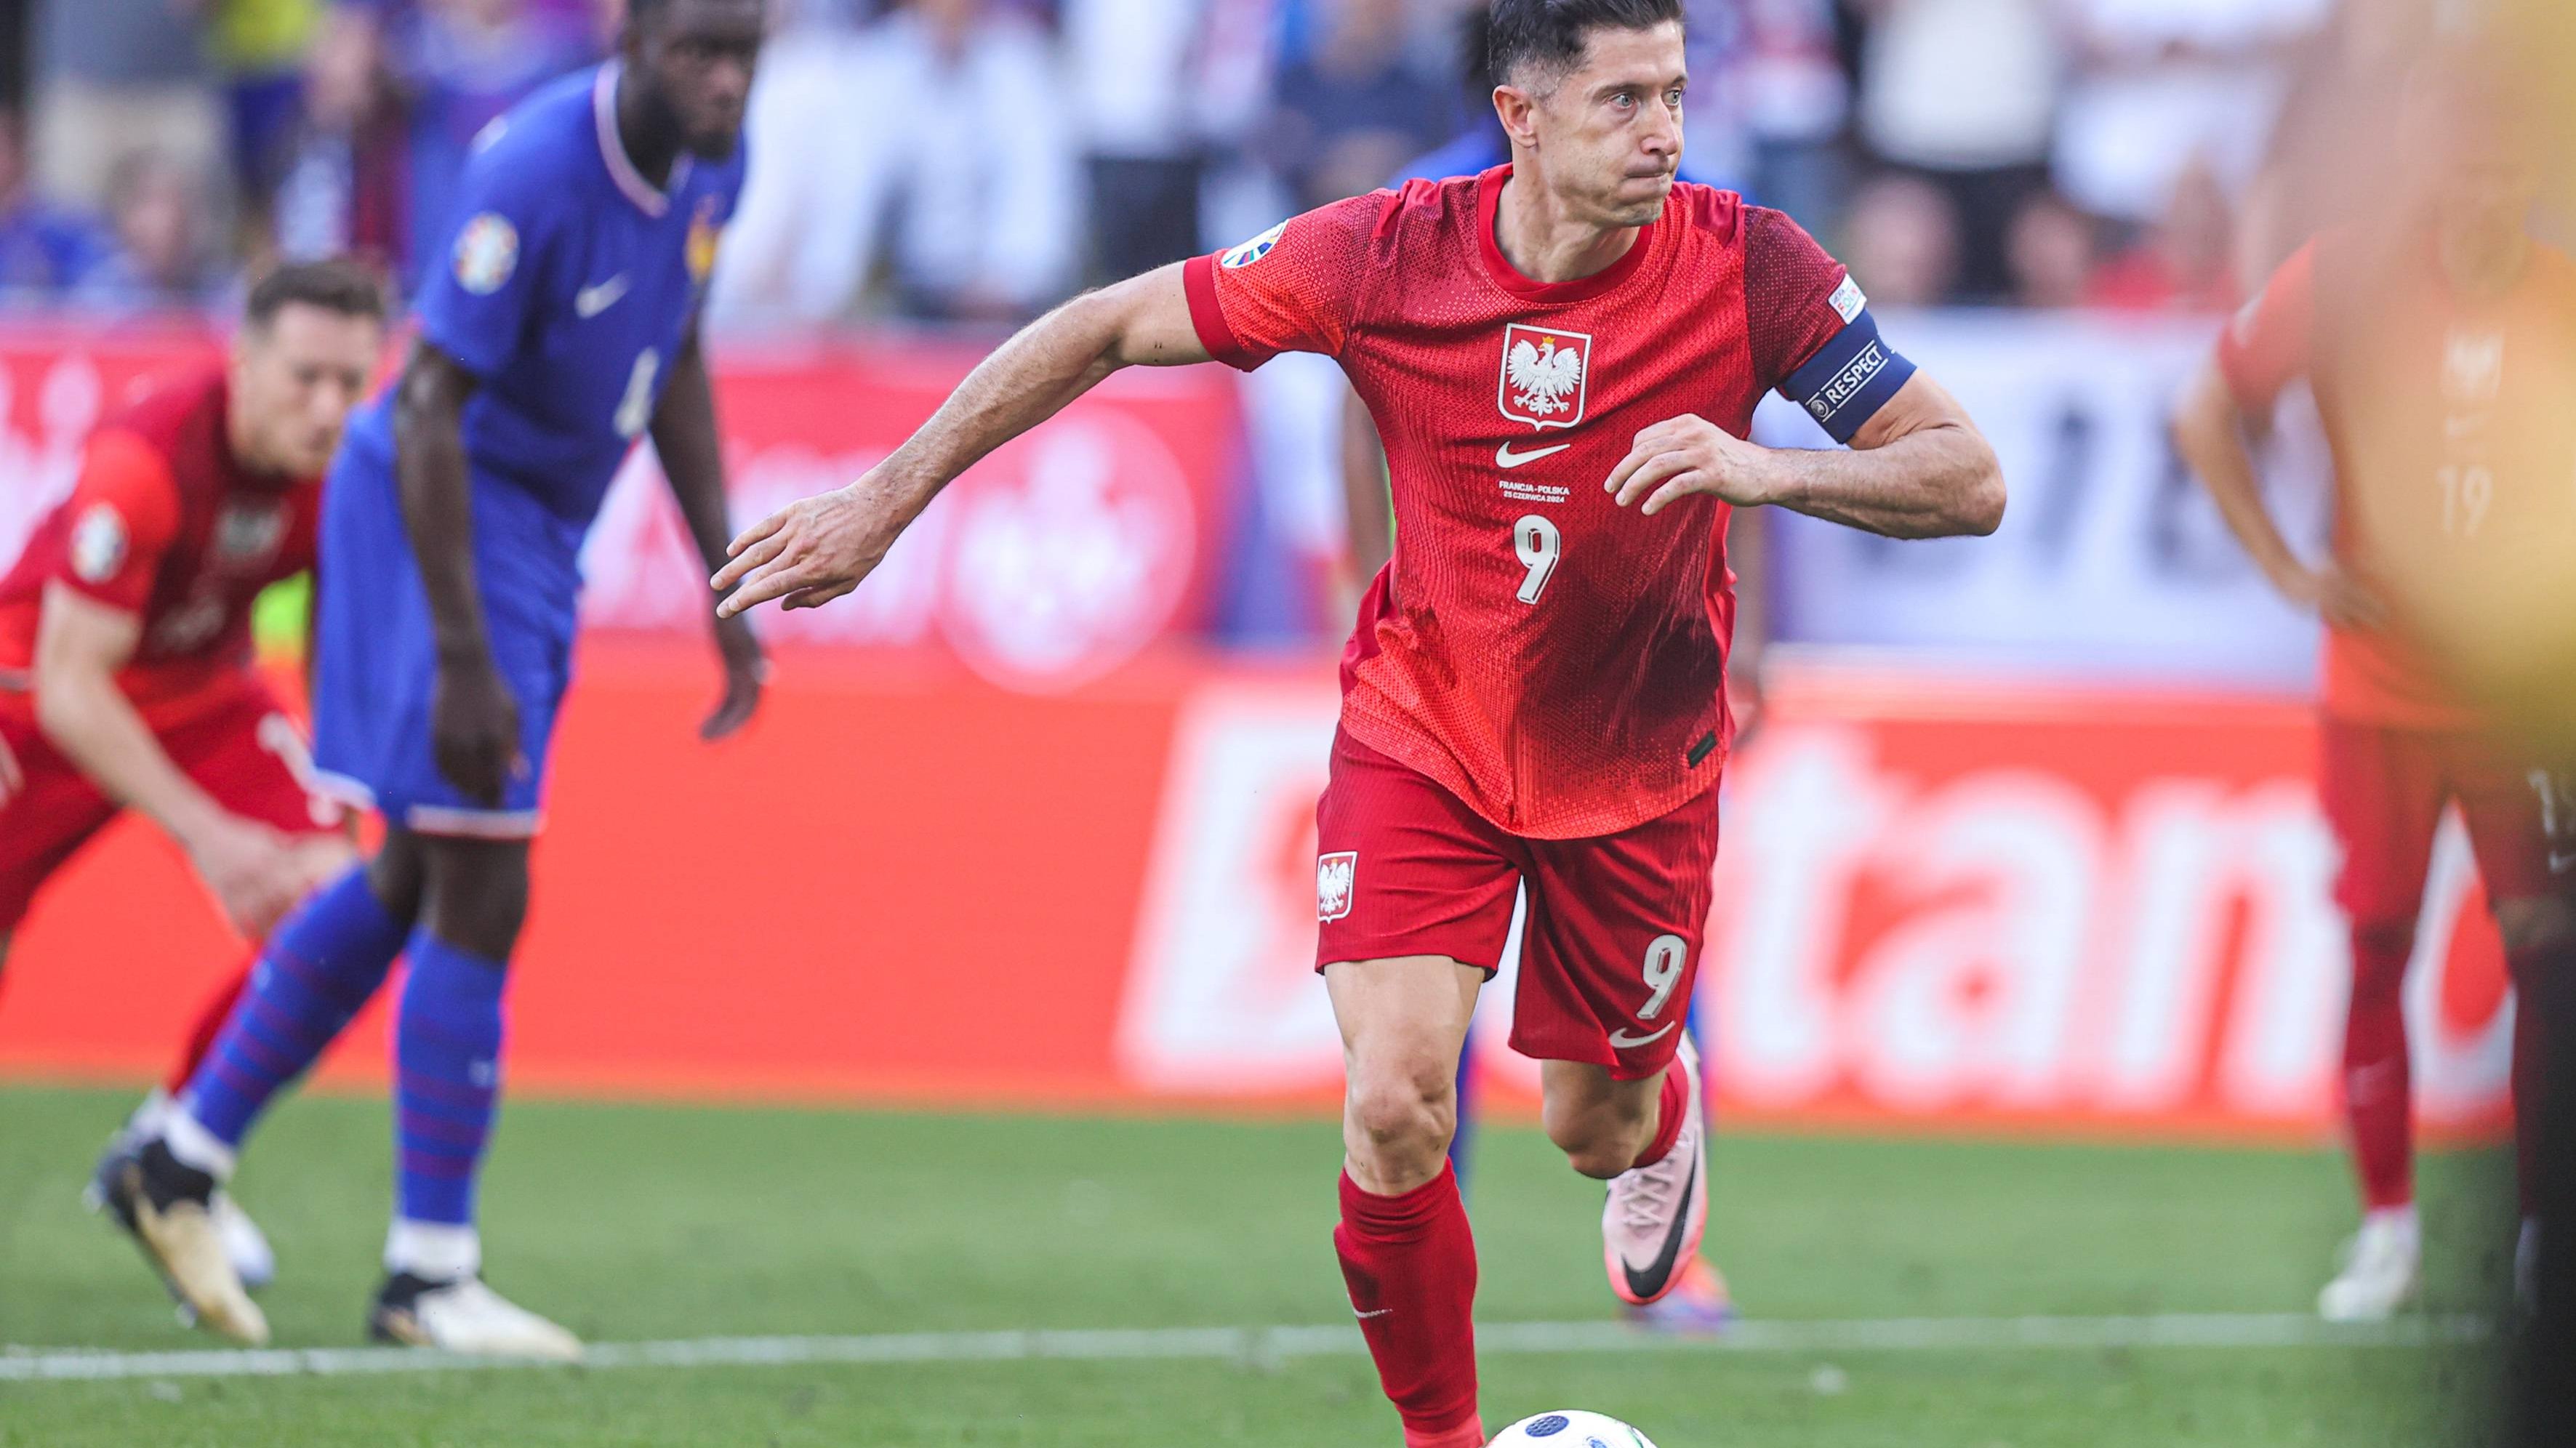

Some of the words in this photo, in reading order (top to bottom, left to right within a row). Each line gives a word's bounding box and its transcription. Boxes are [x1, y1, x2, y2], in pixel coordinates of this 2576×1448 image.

[1825, 345, 1883, 405] RESPECT
[1498, 480, 1534, 492] FRANCJA
[1538, 485, 1570, 495] POLSKA
[1513, 492, 1546, 502] CZERWCA
[2437, 464, 2494, 536] 19
[1513, 514, 1561, 605] 9
[1112, 691, 2520, 1105] Btan
[1636, 933, 1688, 1020] 9
